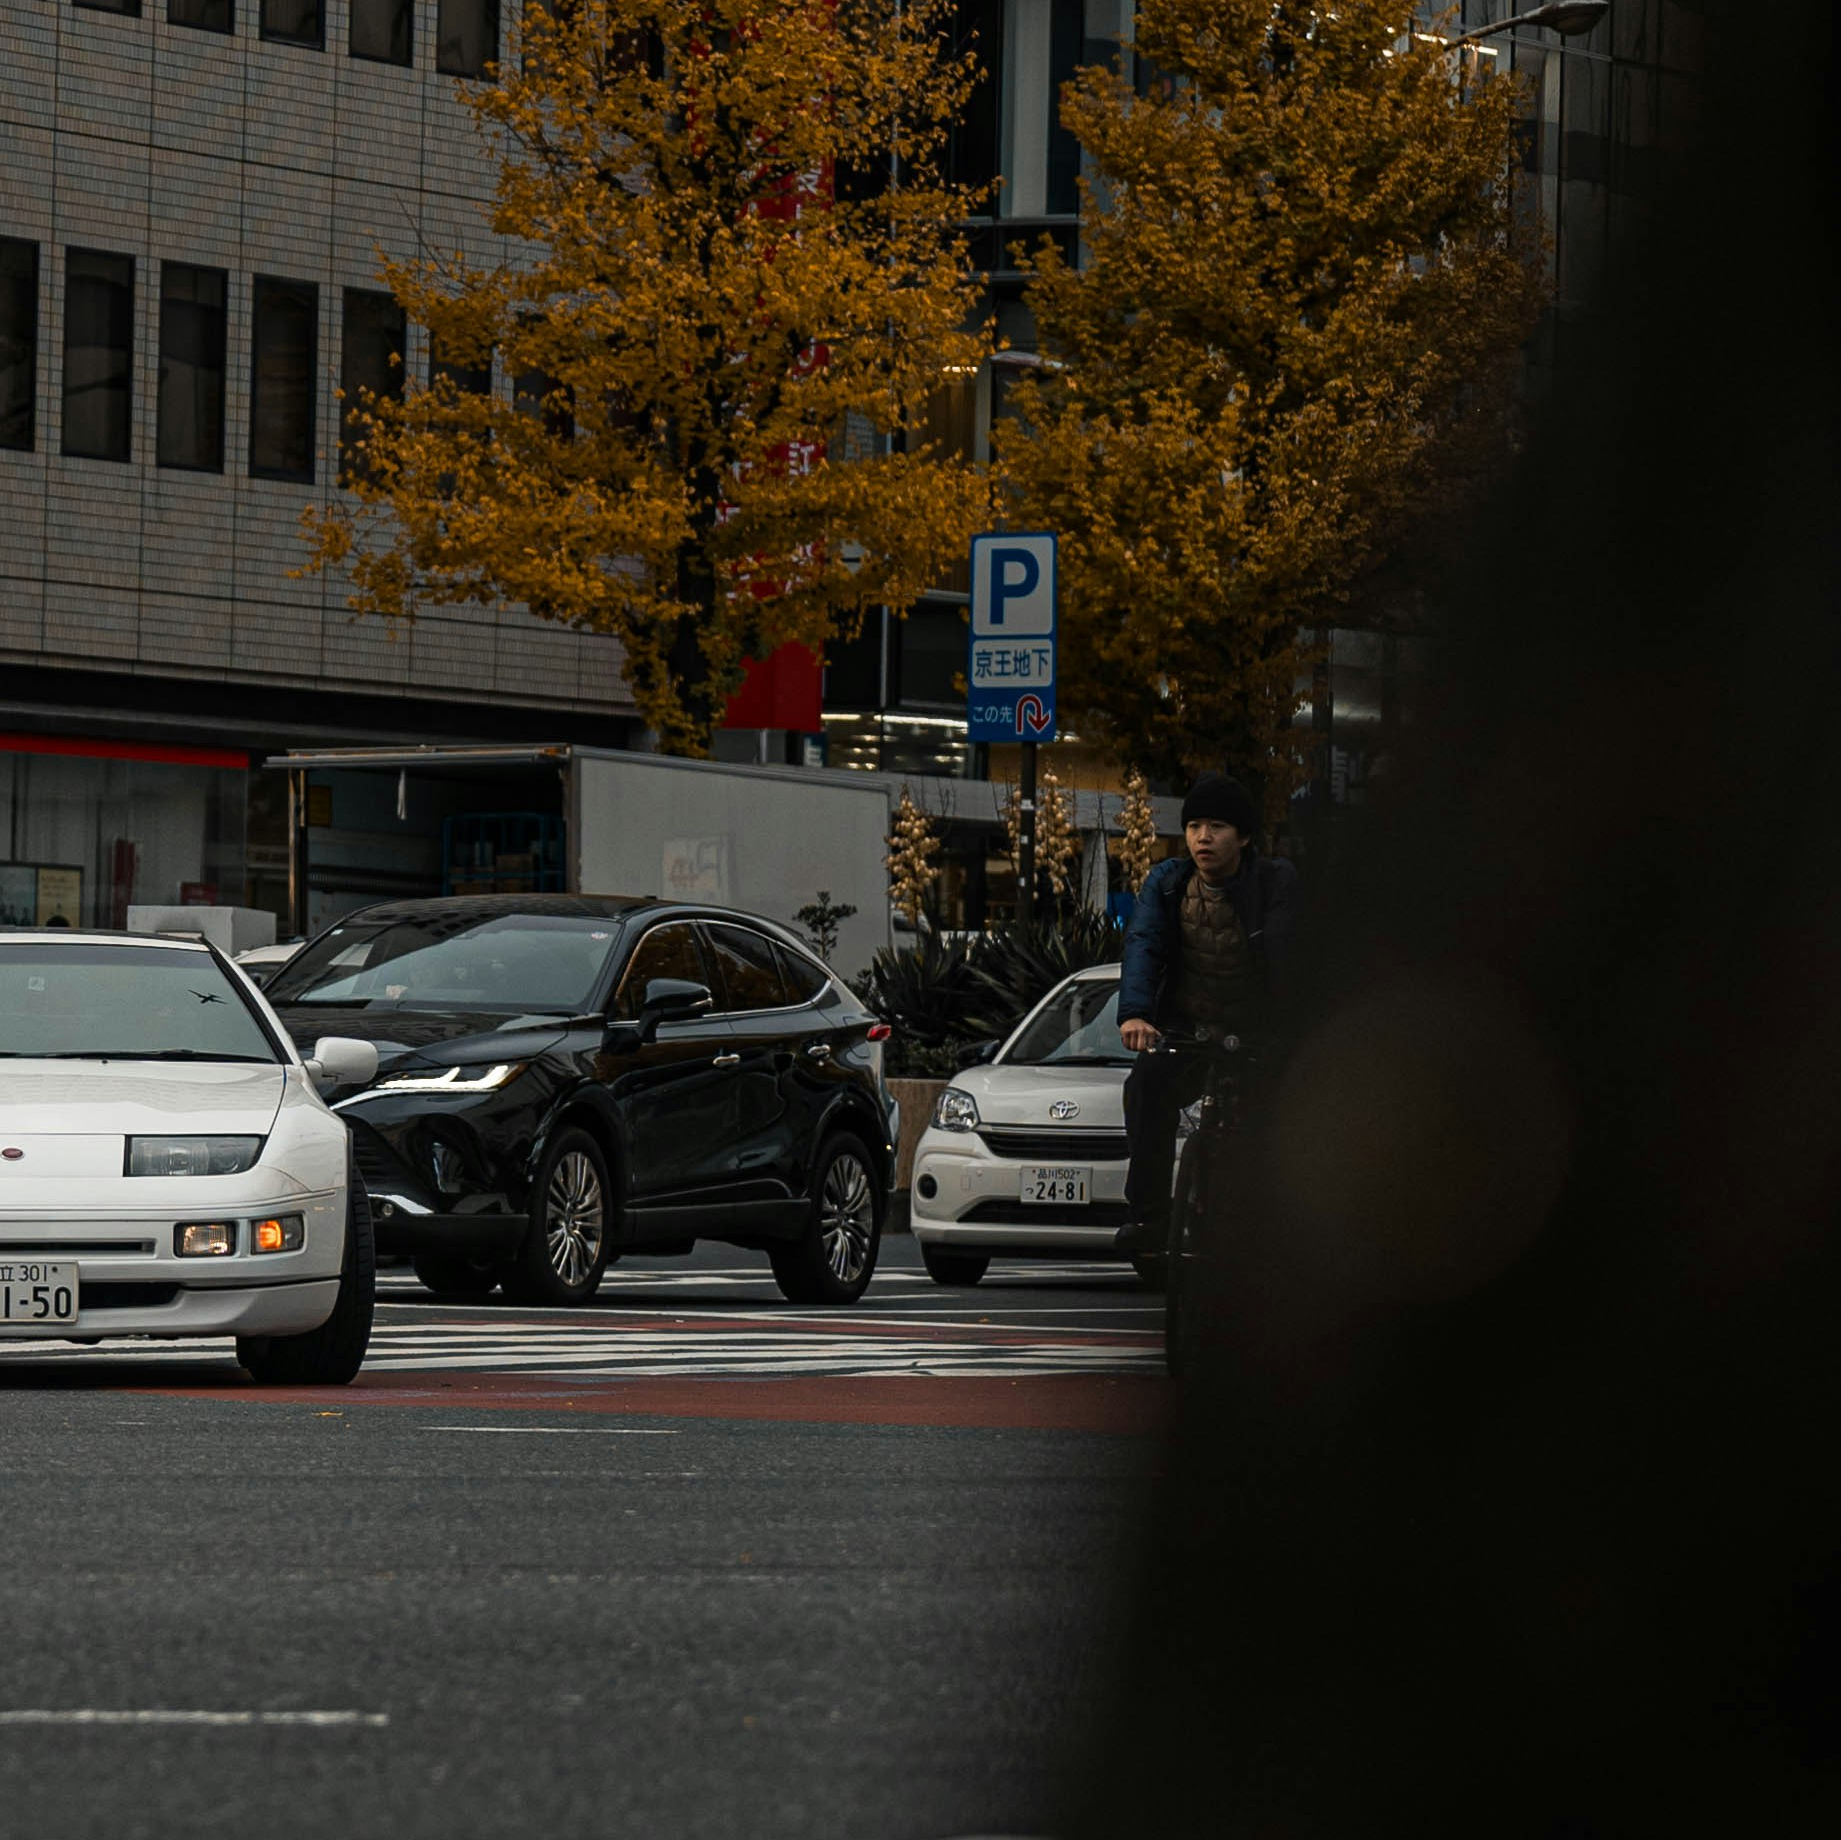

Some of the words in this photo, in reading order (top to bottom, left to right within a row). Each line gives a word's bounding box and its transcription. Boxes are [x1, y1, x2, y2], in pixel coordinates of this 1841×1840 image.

[990, 549, 1039, 624] P
[975, 649, 1050, 677] 京王地下
[972, 705, 1012, 724] この先
[1036, 1181, 1084, 1200] 24-81
